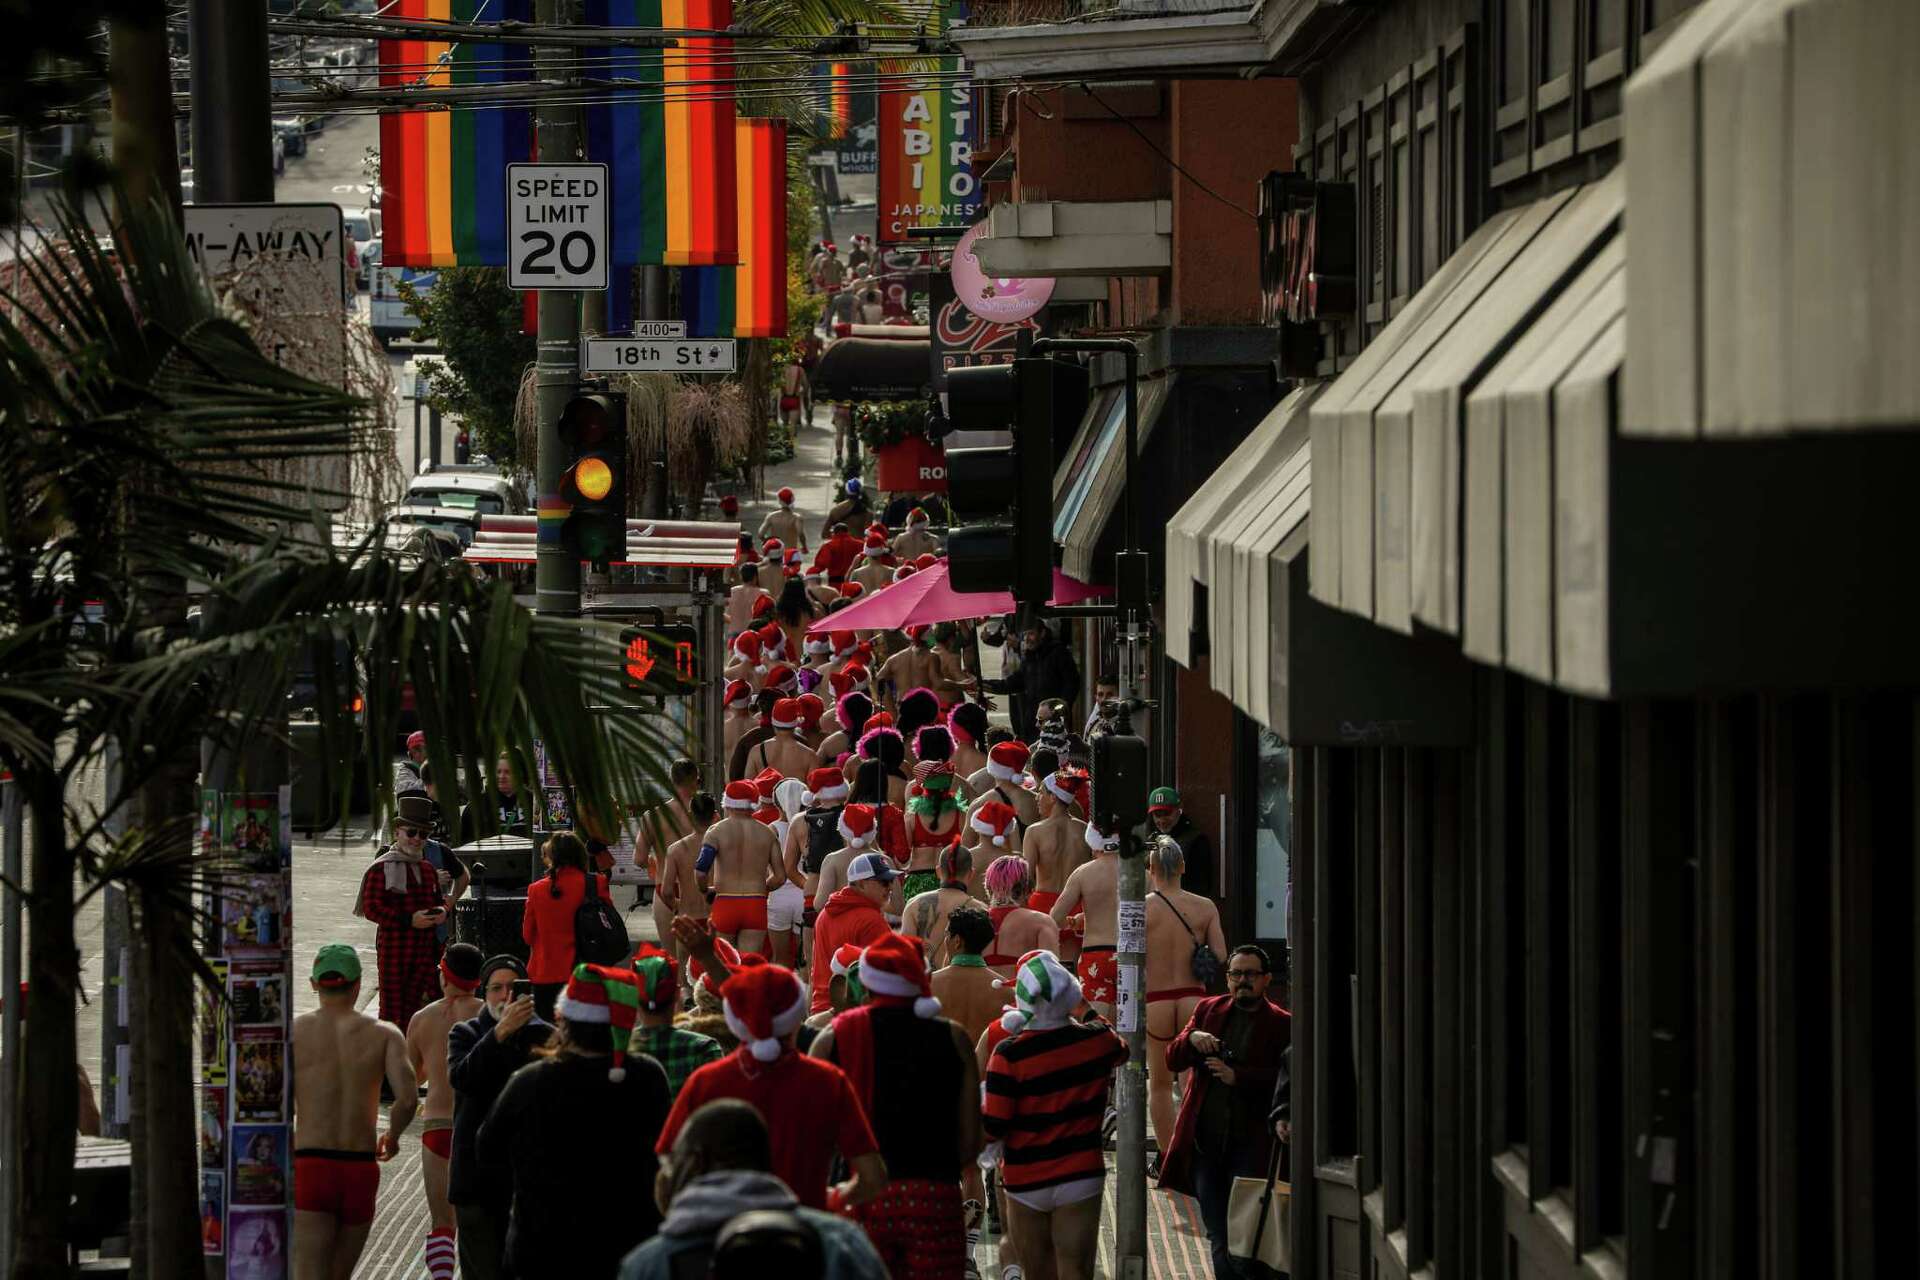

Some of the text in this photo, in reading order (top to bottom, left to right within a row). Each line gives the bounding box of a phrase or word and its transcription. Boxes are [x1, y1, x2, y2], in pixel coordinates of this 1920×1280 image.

[517, 179, 599, 198] SPEED
[525, 204, 590, 224] LIMIT
[891, 203, 982, 216] JAPANES
[519, 230, 597, 276] 20
[640, 323, 670, 336] 4100
[615, 346, 704, 365] 18th St
[943, 354, 1015, 371] PIZZ
[919, 466, 949, 480] RO
